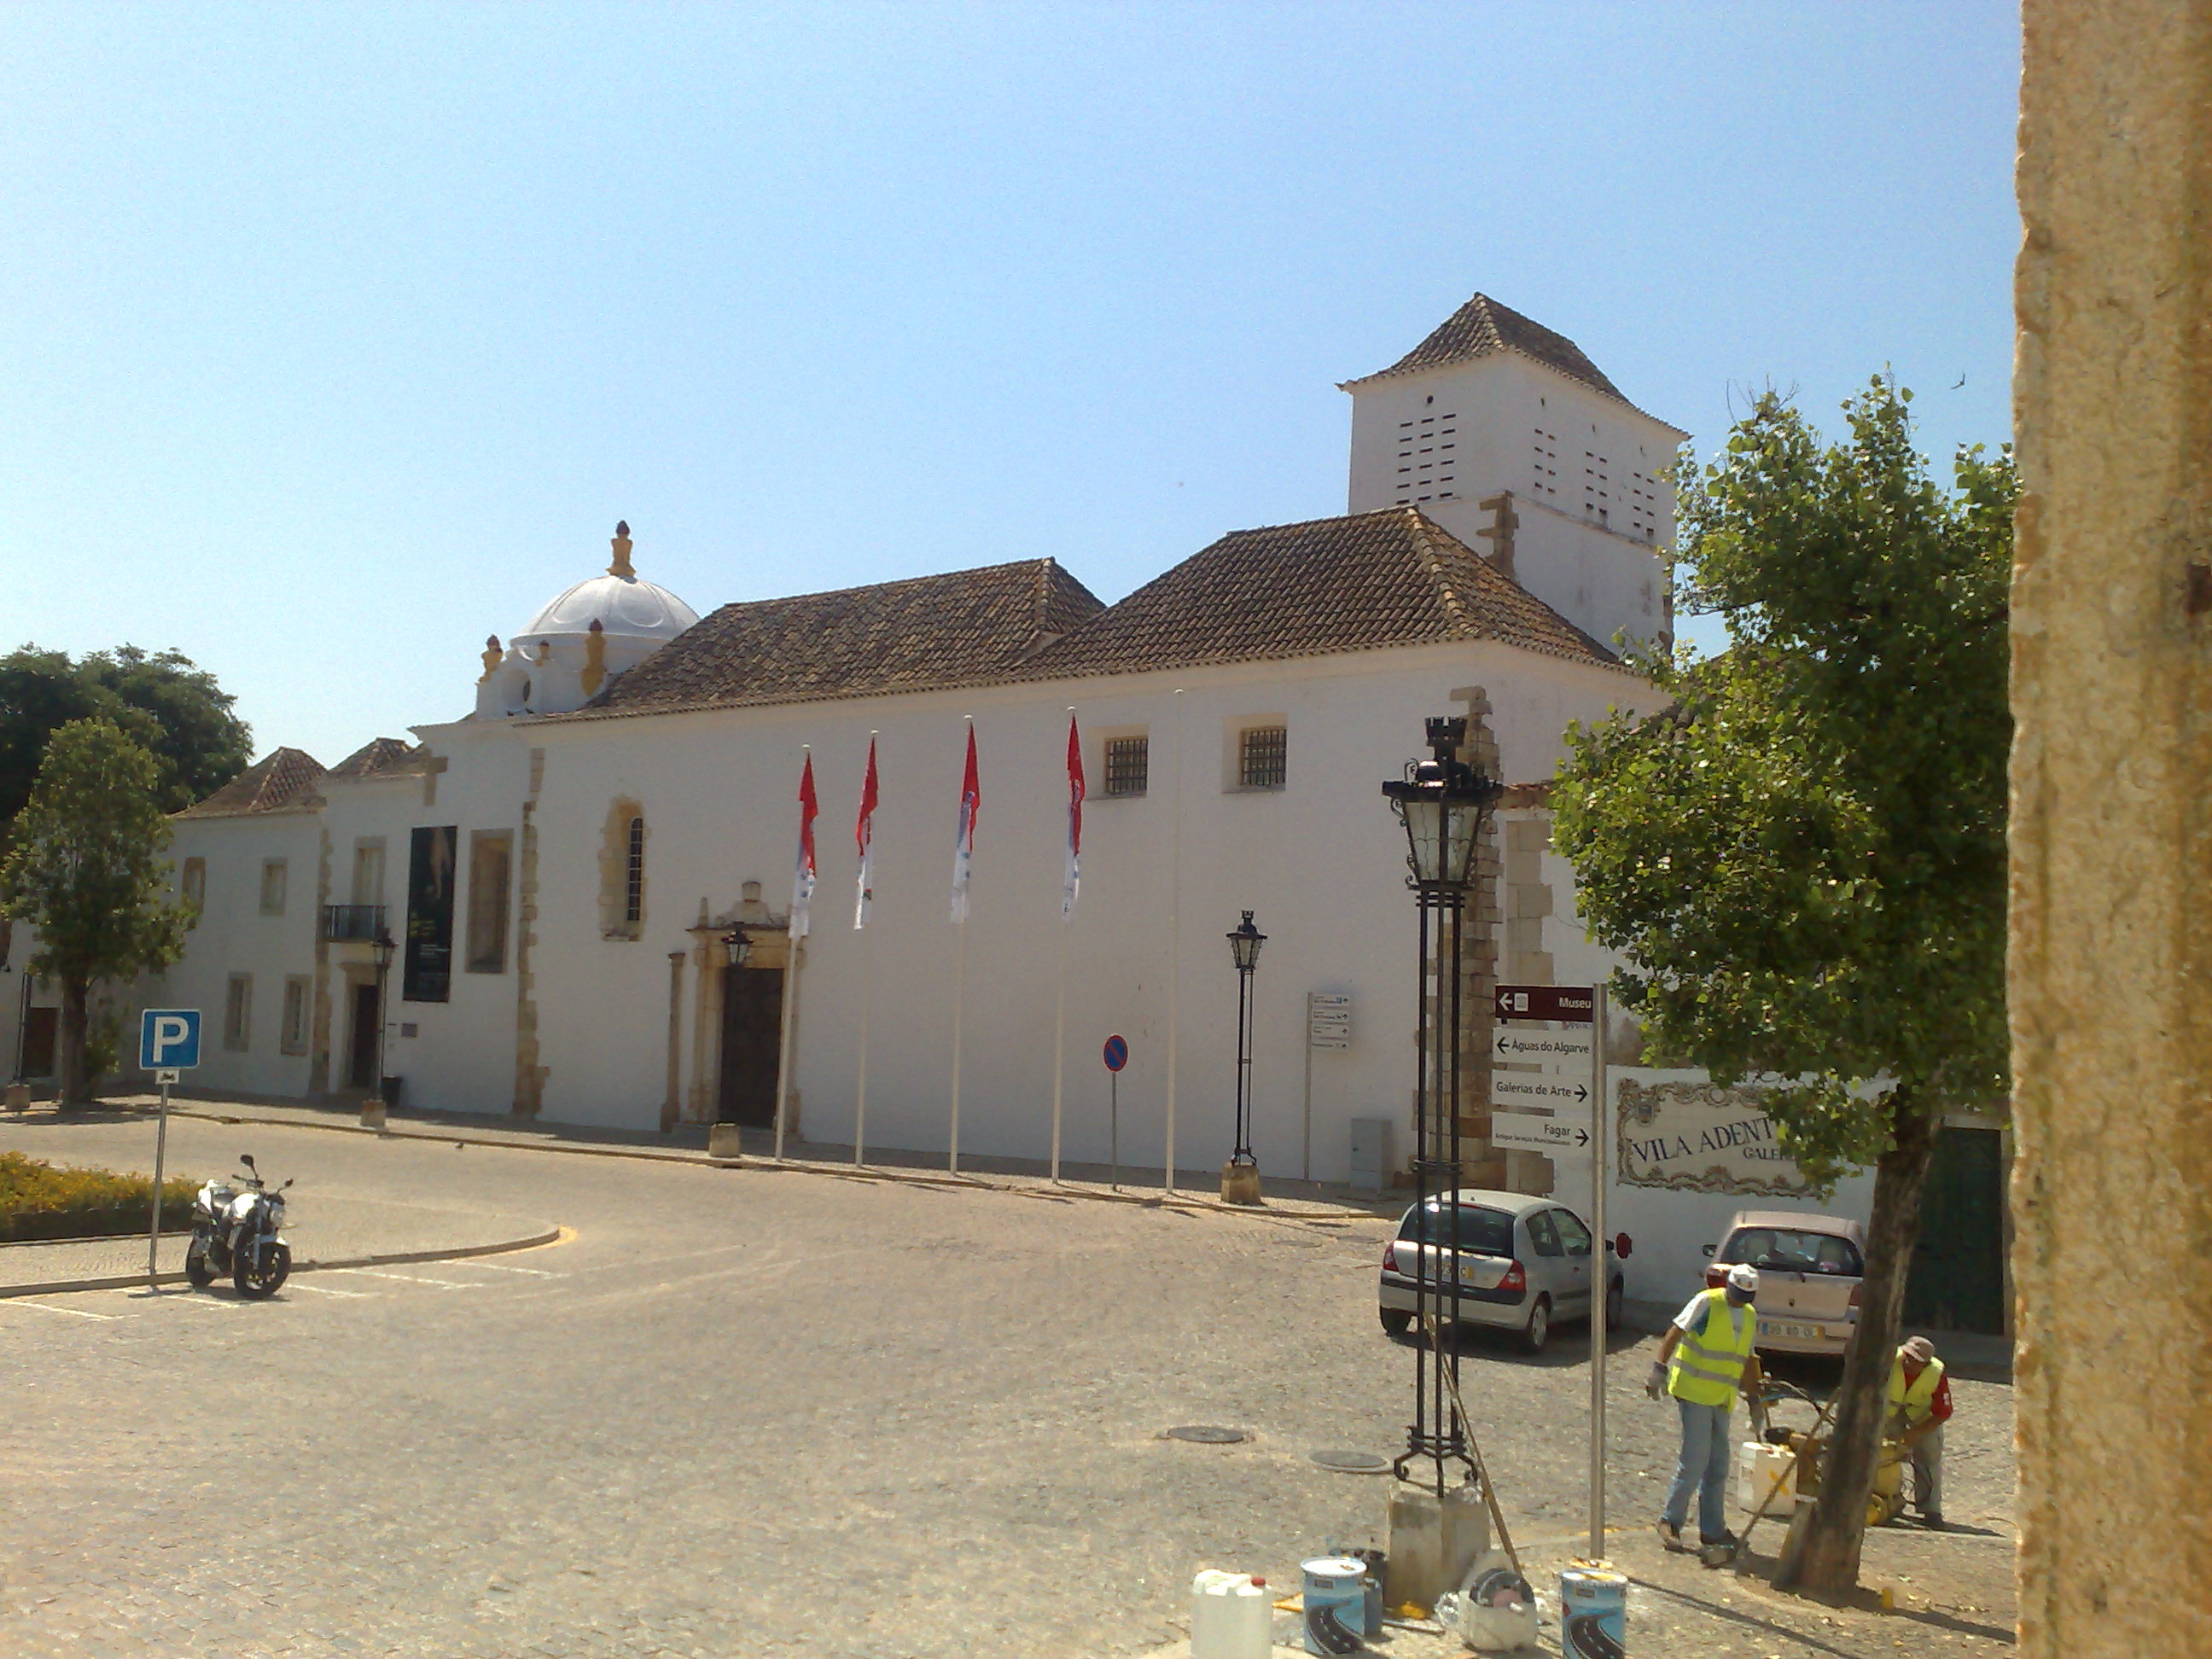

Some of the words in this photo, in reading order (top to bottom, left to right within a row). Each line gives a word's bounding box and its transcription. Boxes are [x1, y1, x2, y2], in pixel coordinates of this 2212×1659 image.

[1558, 996, 1592, 1009] Museu
[154, 1016, 189, 1062] P
[1511, 1038, 1540, 1052] Águas
[1540, 1041, 1552, 1052] do
[1554, 1042, 1590, 1055] Algarve
[1496, 1081, 1534, 1094] Galerias
[1535, 1084, 1548, 1095] de
[1550, 1086, 1572, 1097] Arte
[1544, 1124, 1571, 1138] Fagar
[1630, 1135, 1693, 1162] VILA
[1700, 1116, 1773, 1152] ADENT
